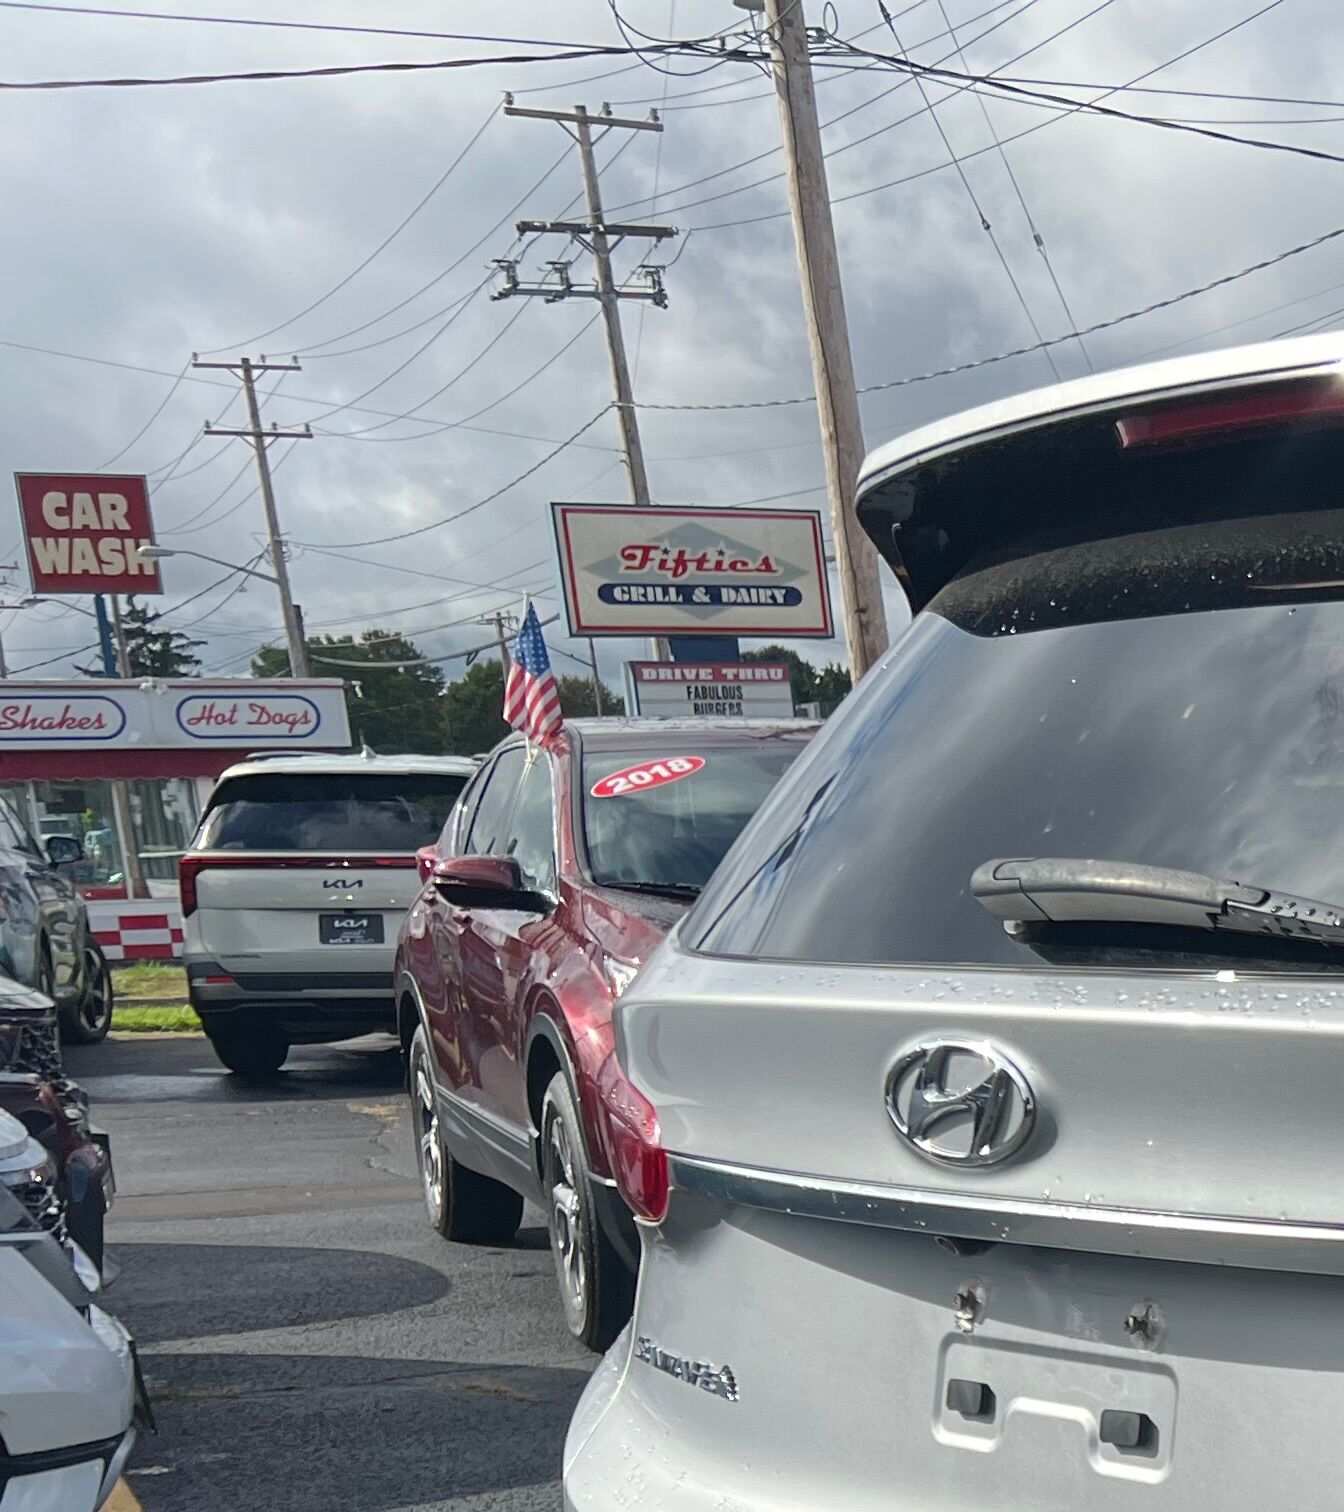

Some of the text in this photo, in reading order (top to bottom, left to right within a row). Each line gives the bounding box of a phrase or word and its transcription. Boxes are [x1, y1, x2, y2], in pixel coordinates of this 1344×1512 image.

[42, 491, 132, 530] CAR
[31, 537, 155, 576] WASH
[620, 542, 779, 579] Fifties
[612, 586, 787, 605] GRILL & DAIRY
[641, 668, 784, 681] DRIVE THRU
[686, 685, 743, 700] FABULOUS
[0, 704, 107, 730] Shakes
[187, 702, 312, 733] Hot Dogs
[693, 702, 743, 716] BURGERS
[605, 758, 694, 793] 2018
